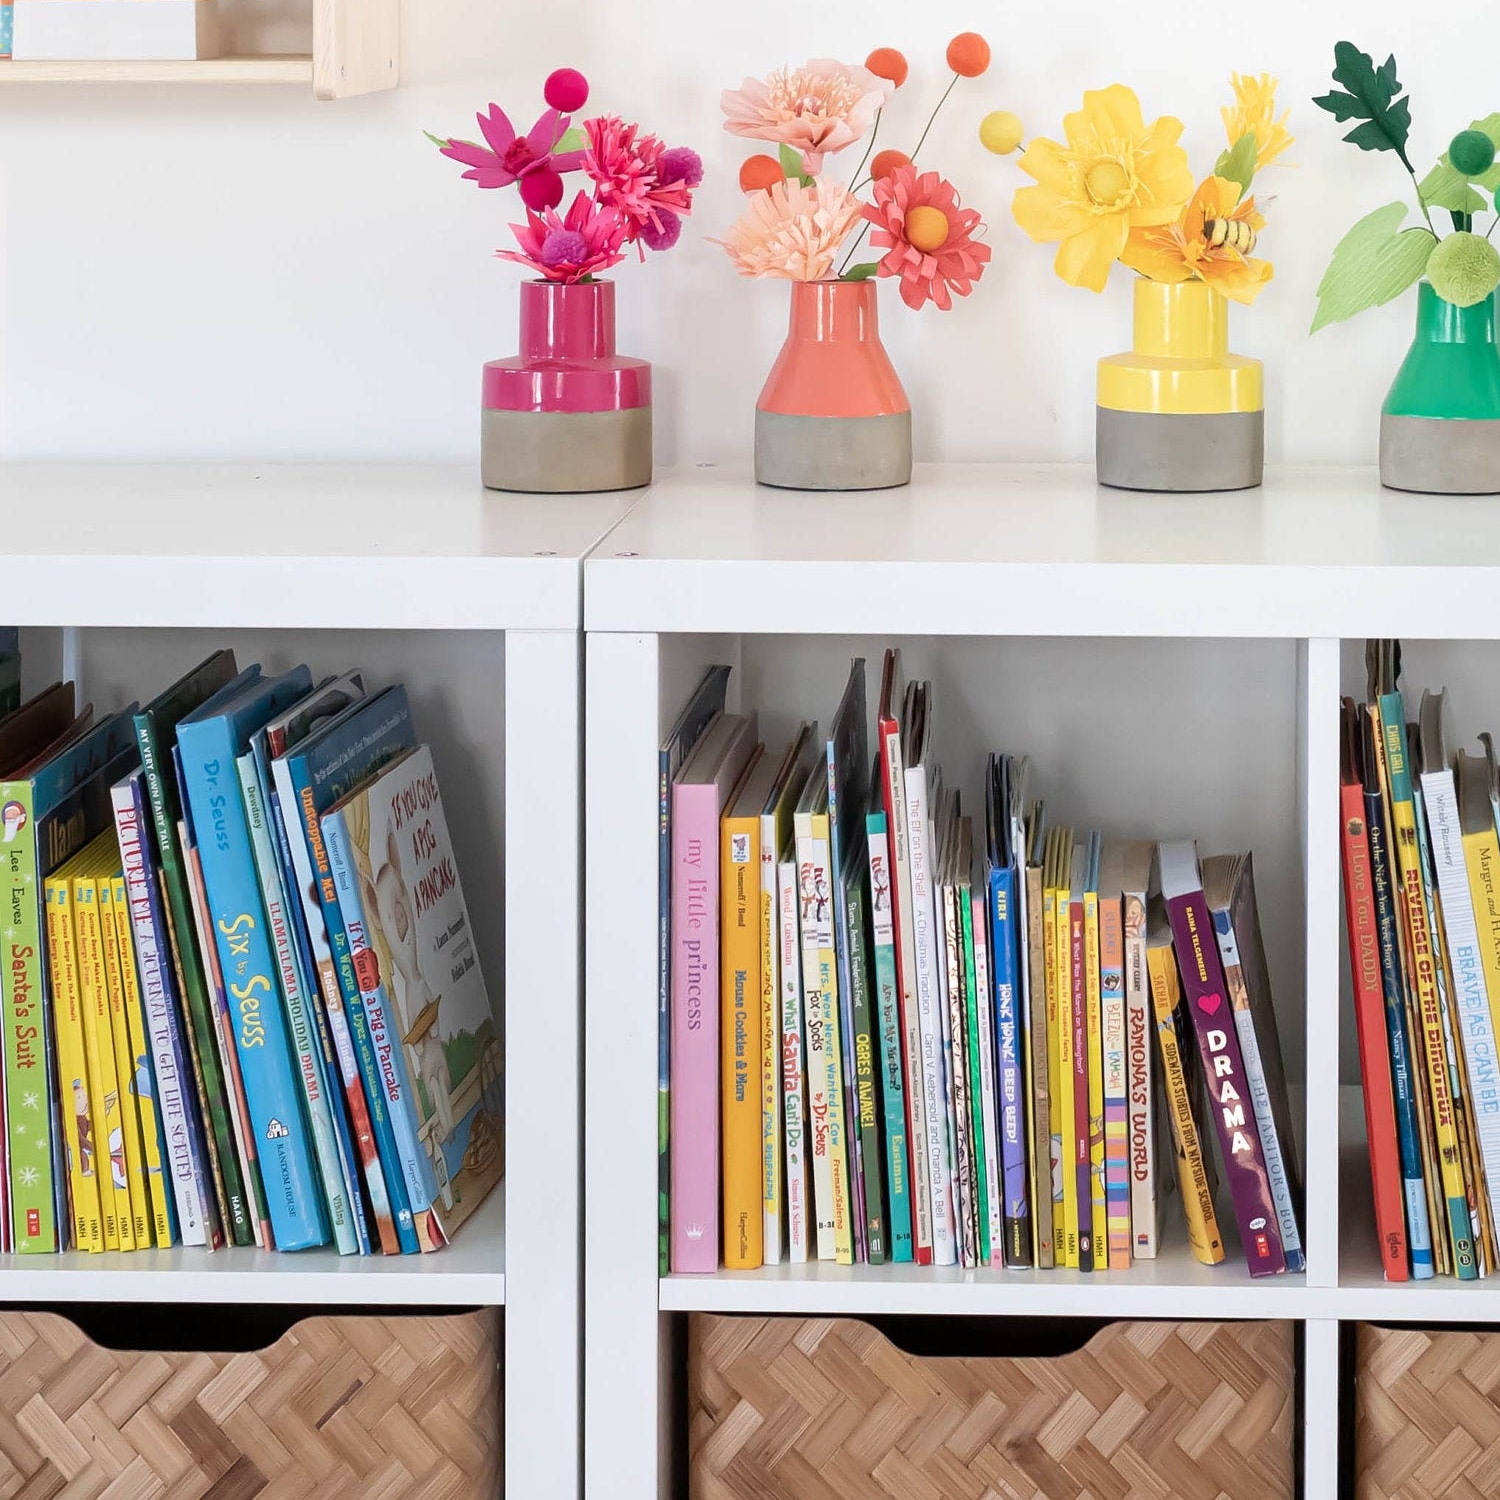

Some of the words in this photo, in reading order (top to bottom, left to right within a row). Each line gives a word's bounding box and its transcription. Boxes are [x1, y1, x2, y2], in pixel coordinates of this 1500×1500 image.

[139, 729, 148, 744] MY
[144, 747, 154, 770] VERY
[204, 759, 220, 791] Dr.
[149, 773, 159, 797] OWN
[153, 798, 165, 827] FAIRY
[210, 796, 229, 850] Seuss
[248, 786, 261, 829] Dewdney
[117, 807, 145, 892] PICTURE
[159, 829, 169, 850] TALE
[300, 786, 328, 874] Unstoppable
[320, 878, 336, 903] Me!
[683, 840, 700, 868] my
[10, 850, 22, 872] Lee
[1352, 855, 1365, 891] Love
[1480, 848, 1493, 894] Margret
[1488, 897, 1500, 919] and
[12, 887, 24, 925] Eaves
[132, 898, 152, 927] ME
[688, 880, 707, 929] little
[997, 891, 1007, 920] KIRK
[1358, 893, 1369, 930] You,
[1406, 869, 1428, 955] REVENGE
[218, 913, 256, 957] Six
[348, 921, 362, 935] If
[1185, 906, 1195, 933] RAINA
[1191, 933, 1207, 982] TELGEMEIER
[235, 960, 249, 975] by
[821, 963, 829, 988] Mrs.
[1360, 934, 1377, 991] DADDY
[1418, 960, 1432, 983] OF
[1457, 946, 1481, 1010] BRAVE
[12, 944, 36, 1018] Santa's
[143, 952, 166, 1021] JOURNAL
[683, 940, 707, 1031] princess
[735, 970, 746, 1007] Mouse
[882, 984, 893, 1000] Are
[1153, 975, 1168, 1008] SACHAR
[231, 974, 271, 1049] Seuss
[269, 902, 284, 947] LLAMA
[279, 949, 298, 995] LLAMA
[290, 996, 309, 1051] HOLIDAY
[301, 1053, 320, 1102] DRAMA
[367, 998, 375, 1006] a
[784, 1000, 797, 1030] What
[806, 990, 822, 1009] Fox
[822, 993, 832, 1020] Wow
[883, 1004, 892, 1023] You
[999, 984, 1012, 1018] HONK
[1423, 989, 1438, 1024] THE
[155, 1026, 168, 1047] TO
[369, 1007, 384, 1031] Pig
[735, 1012, 747, 1057] Cookies
[808, 1020, 824, 1051] Socks
[885, 1025, 895, 1043] My
[1469, 1014, 1486, 1037] AS
[16, 1025, 37, 1069] Suit
[375, 1034, 384, 1042] a
[824, 1023, 833, 1058] Never
[856, 1033, 870, 1075] OGRES
[1000, 1021, 1015, 1063] HONK!
[159, 1053, 176, 1082] GET
[378, 1044, 399, 1102] Pancake
[783, 1033, 800, 1092] Santa
[888, 1046, 900, 1091] Mother?
[1130, 1007, 1148, 1106] RAMONA'S
[1165, 1043, 1183, 1086] SIDEWAYS
[1473, 1042, 1494, 1085] CAN
[736, 1073, 747, 1101] More
[826, 1063, 840, 1107] Wanted
[1004, 1068, 1016, 1102] BEEP
[1206, 1029, 1250, 1154] DRAMA
[1252, 1073, 1267, 1108] THE
[1428, 1029, 1452, 1127] DINOTRUX
[165, 1088, 183, 1118] LIFE
[813, 1103, 828, 1124] Dr.
[858, 1081, 874, 1128] AWAKE!
[1174, 1088, 1190, 1122] STORIES
[1482, 1089, 1499, 1113] BE
[787, 1128, 800, 1148] Do
[815, 1124, 829, 1156] Seuss
[830, 1120, 840, 1146] Cow
[1006, 1105, 1017, 1144] BEEP!
[1182, 1124, 1195, 1146] FROM
[171, 1124, 192, 1182] SORTED
[1132, 1111, 1148, 1181] WORLD
[1257, 1115, 1286, 1201] JANITOR'S
[1188, 1148, 1205, 1189] WAYSIDE
[231, 1196, 243, 1224] HAAG
[332, 1194, 344, 1226] Viking
[833, 1159, 843, 1229] Freeman/Salerno
[1198, 1188, 1214, 1224] SCHOOL
[1280, 1209, 1296, 1240] BOY
